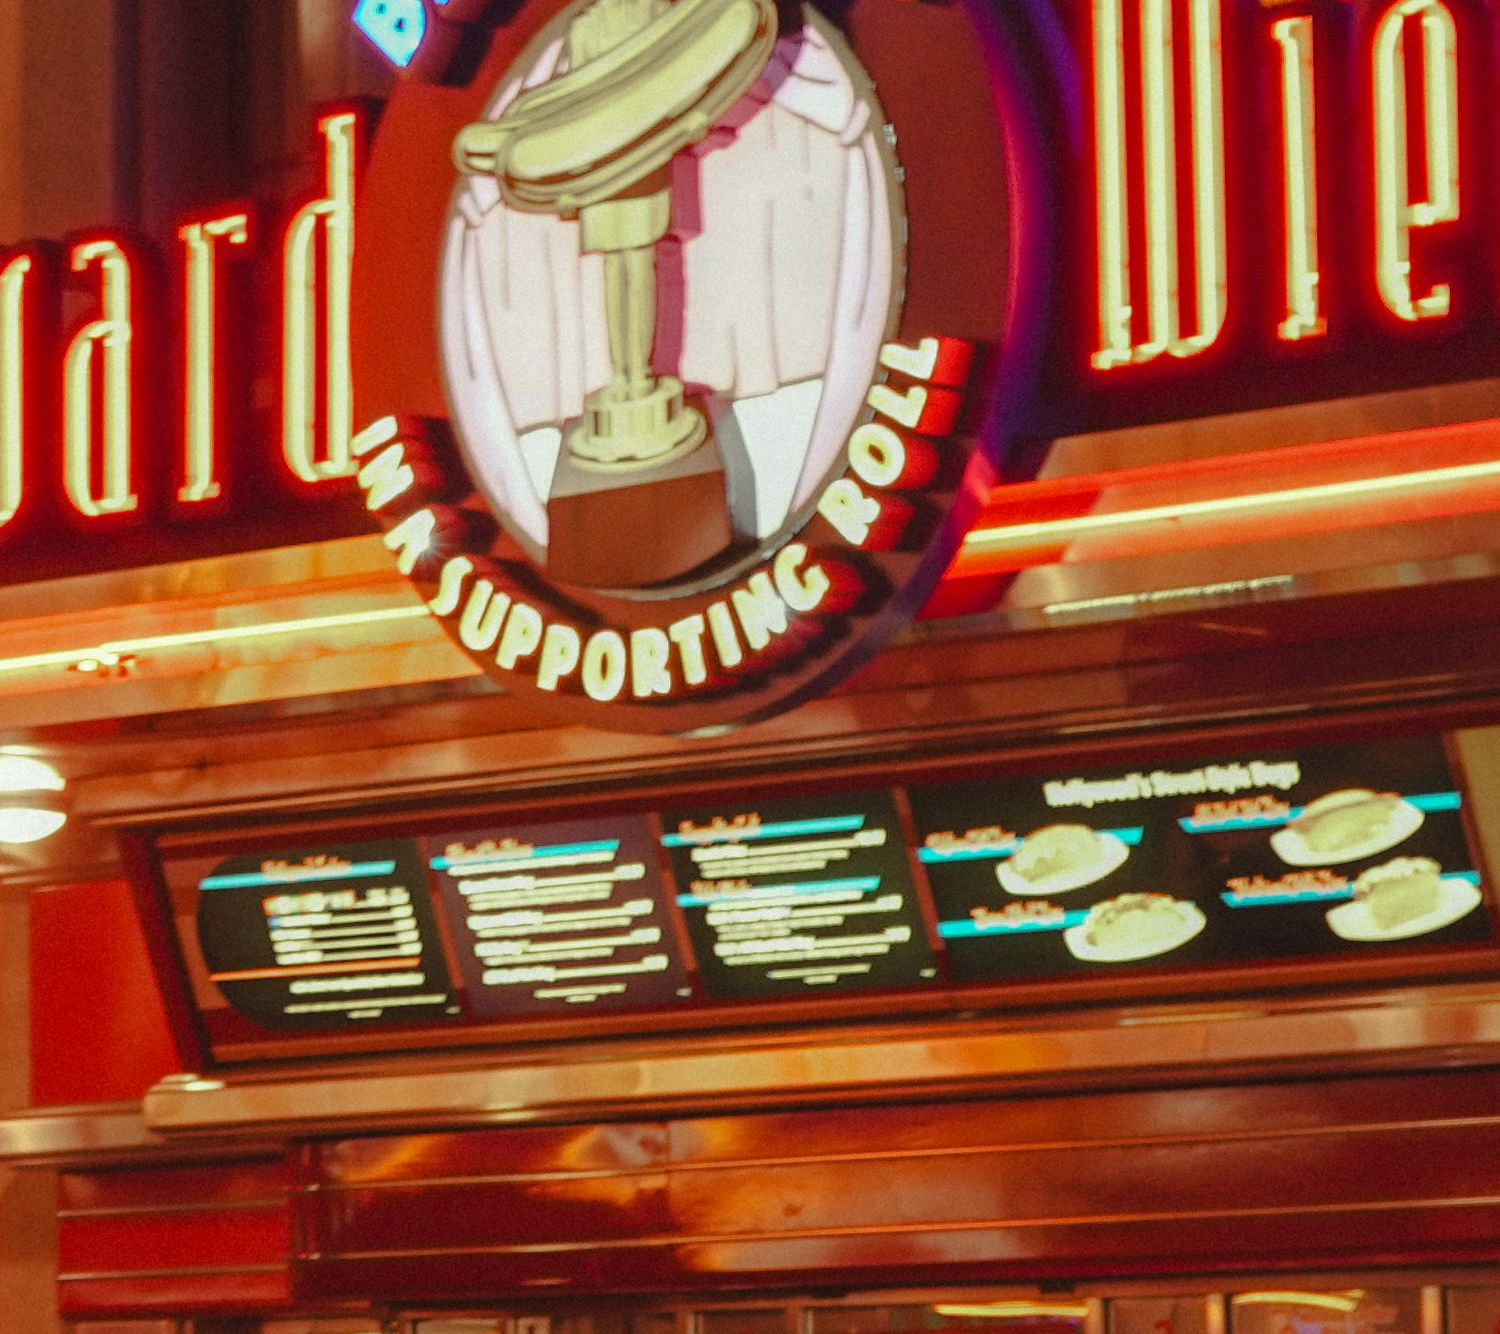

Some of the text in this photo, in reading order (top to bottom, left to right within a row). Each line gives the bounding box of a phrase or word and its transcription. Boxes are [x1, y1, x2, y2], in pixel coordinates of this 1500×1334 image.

[349, 336, 940, 702] IN A SUPPORTING ROLL
